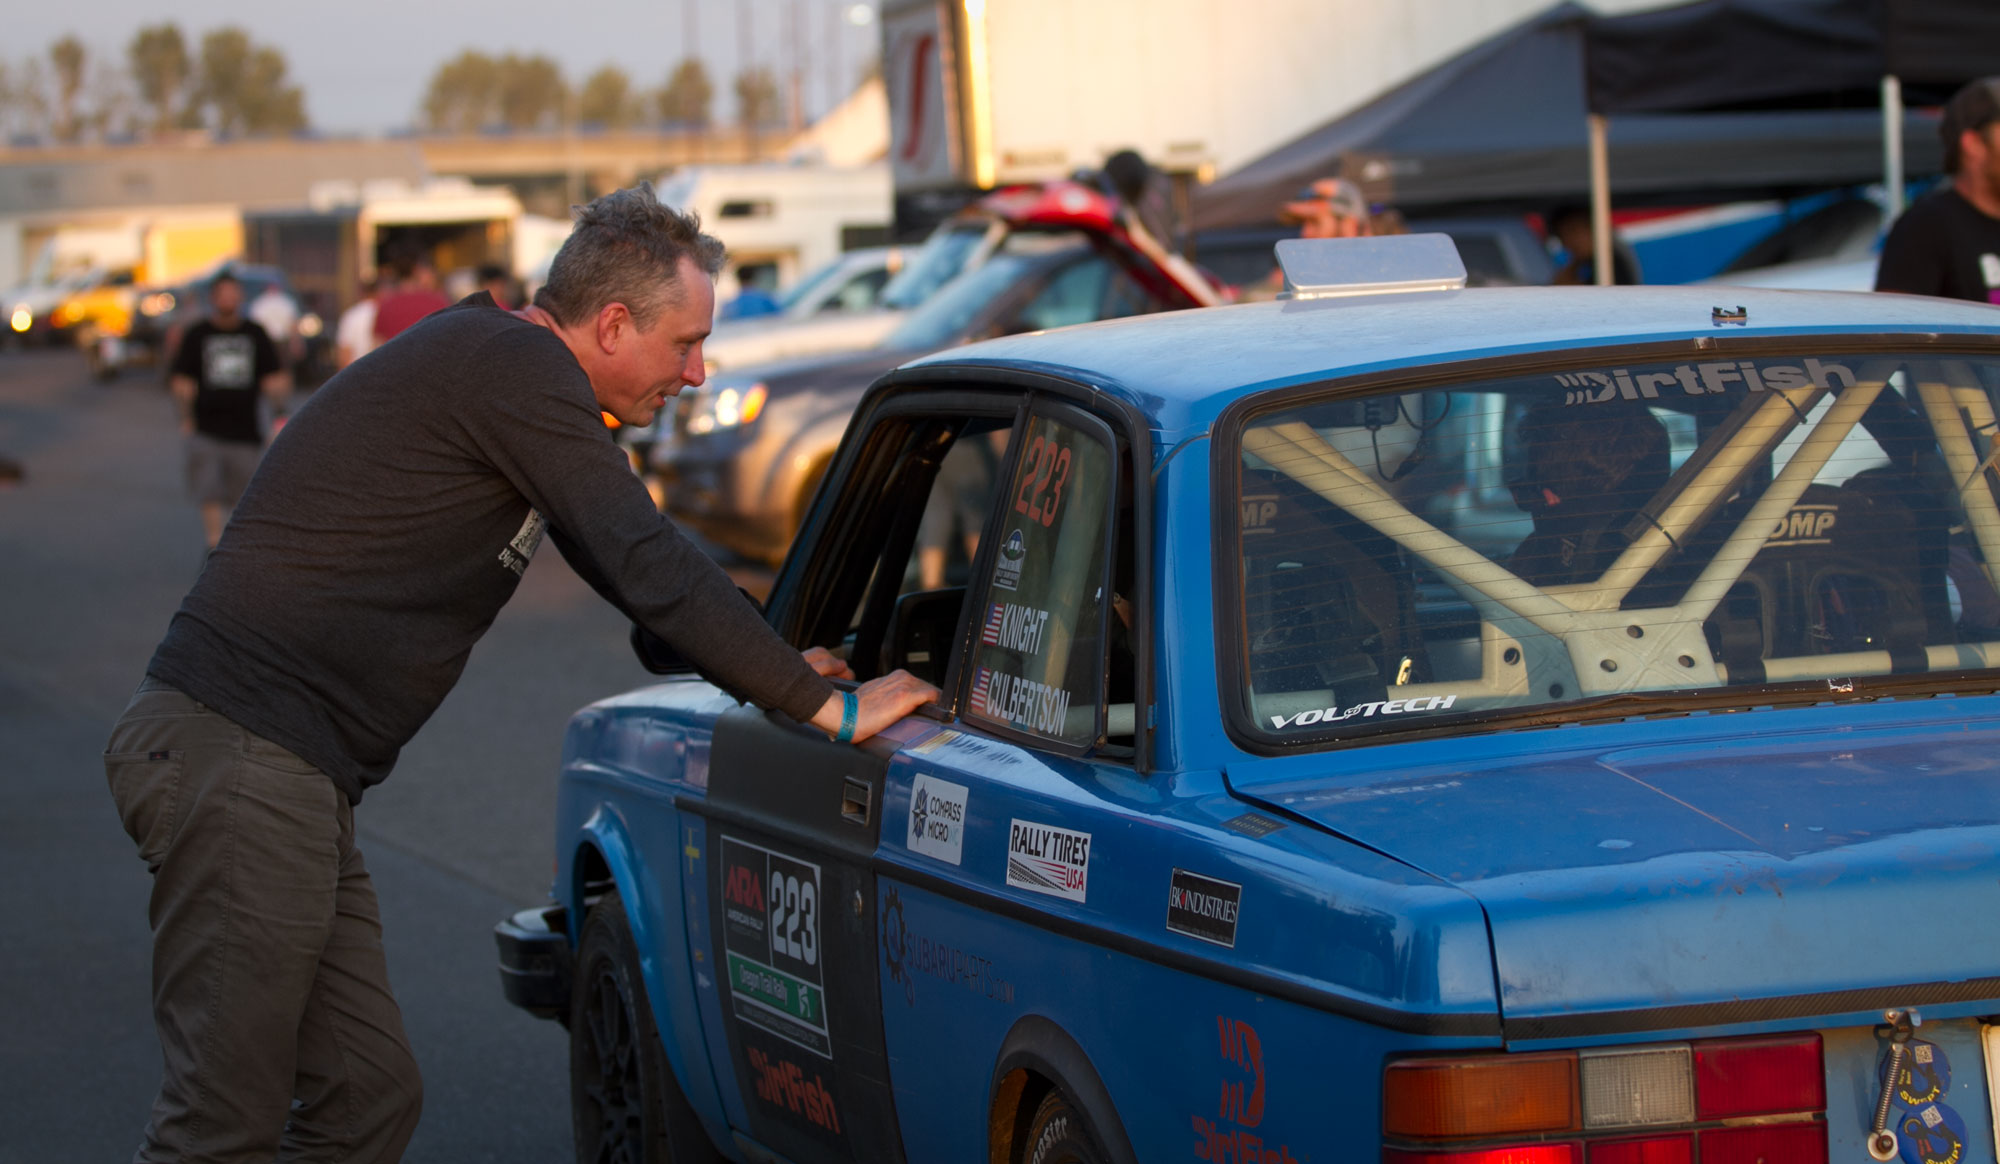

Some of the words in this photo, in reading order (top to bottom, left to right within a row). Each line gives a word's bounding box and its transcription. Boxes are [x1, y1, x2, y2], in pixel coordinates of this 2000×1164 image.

[1553, 359, 1857, 407] DirtFish
[1015, 435, 1071, 528] 223
[999, 603, 1048, 655] KNIGHT
[986, 671, 1070, 736] CULBERTSON
[930, 796, 962, 822] COMPASS
[1011, 824, 1051, 859] RALLY
[1052, 833, 1088, 867] TIRES
[725, 863, 766, 913] ARA
[1066, 868, 1084, 891] USA
[771, 871, 817, 966] 223
[1900, 1085, 1940, 1105] SWEPT
